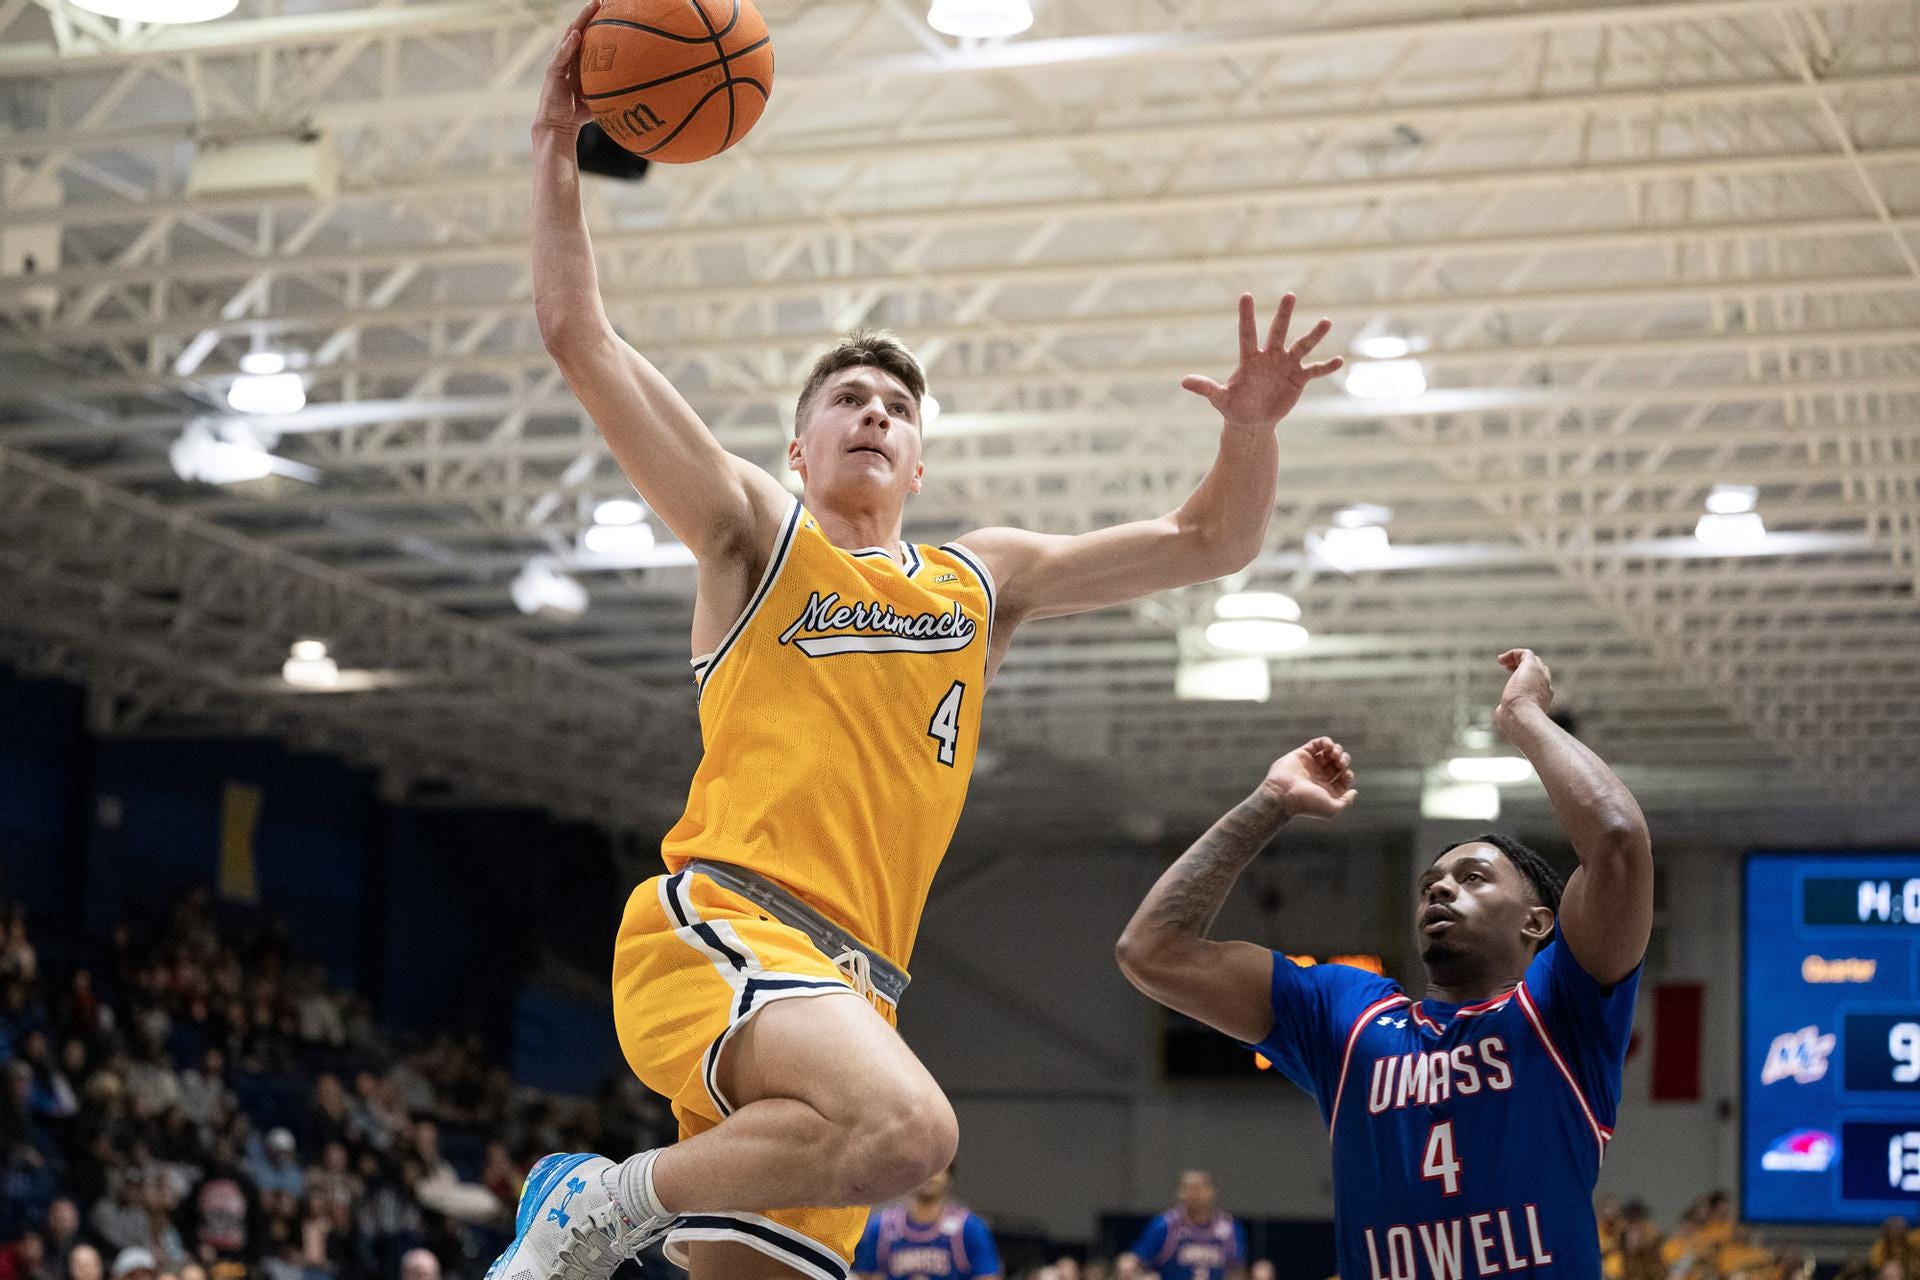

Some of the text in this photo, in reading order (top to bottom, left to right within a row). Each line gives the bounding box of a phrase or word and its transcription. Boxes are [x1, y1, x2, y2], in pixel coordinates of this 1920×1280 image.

[778, 591, 977, 648] Merrimack
[927, 680, 966, 768] 4
[1368, 1036, 1513, 1116] UMASS
[1421, 1119, 1462, 1197] 4
[1364, 1204, 1552, 1280] LOWELL
